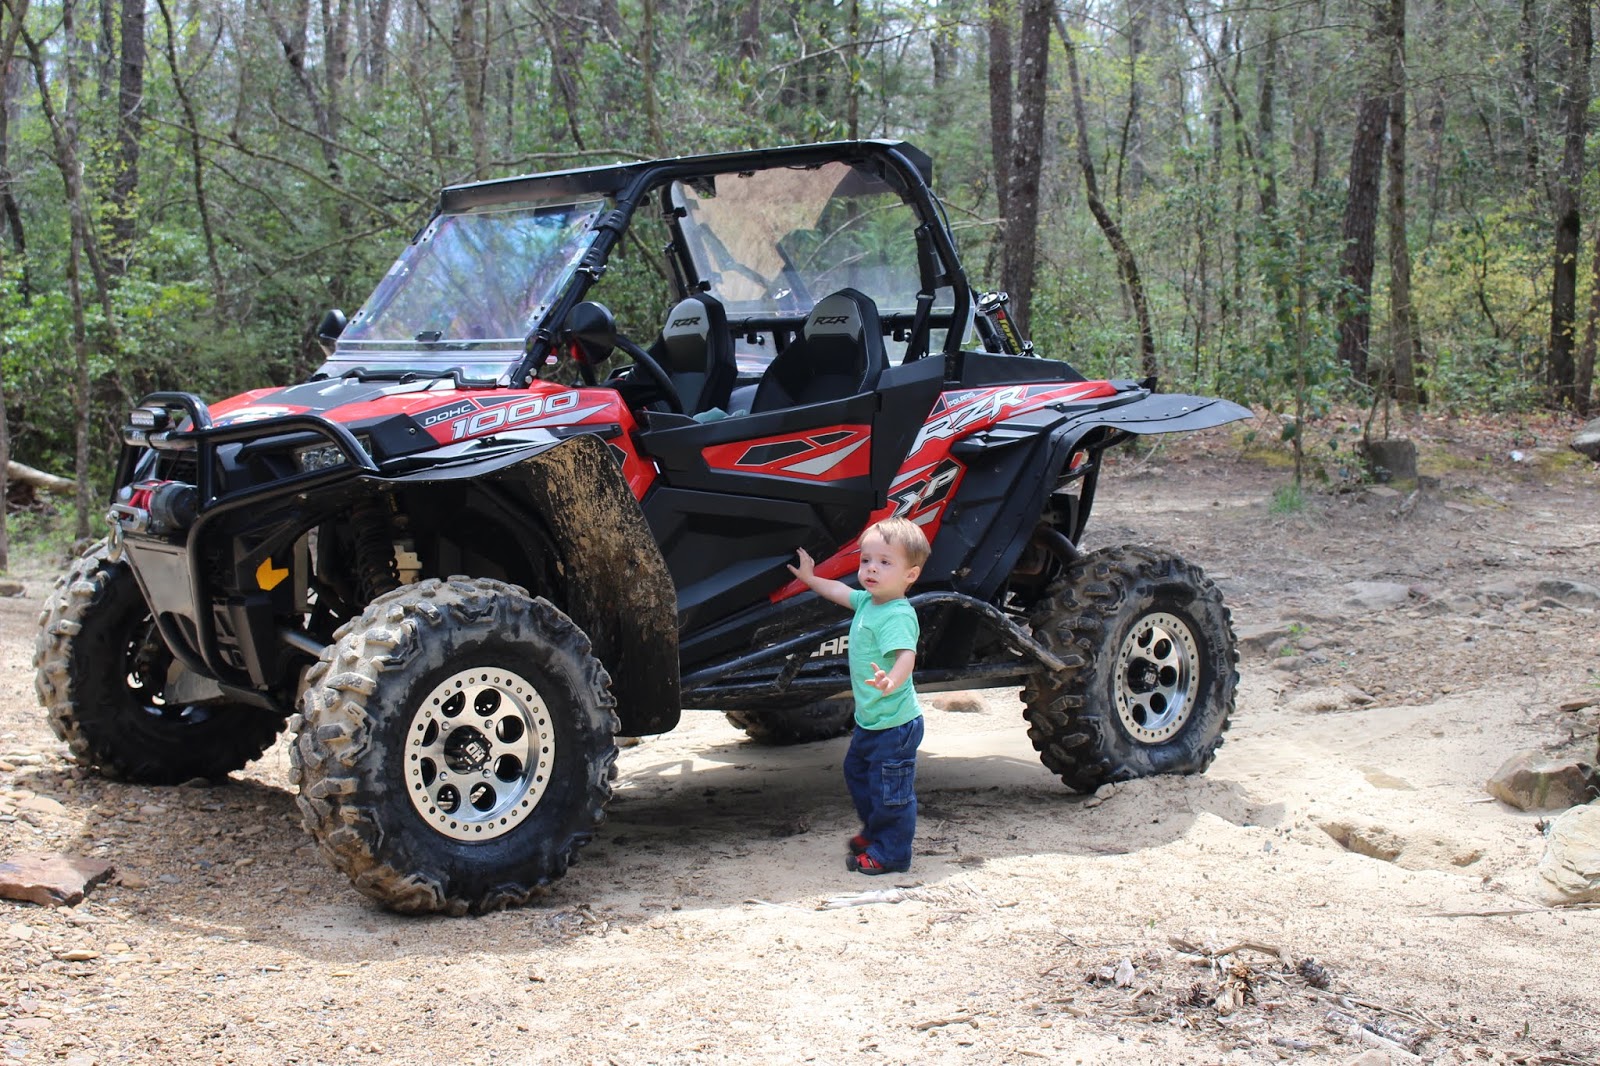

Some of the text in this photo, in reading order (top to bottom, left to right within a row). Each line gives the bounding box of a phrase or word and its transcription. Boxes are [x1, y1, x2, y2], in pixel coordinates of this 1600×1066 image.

[671, 316, 700, 328] RZR
[813, 315, 849, 325] RZR
[947, 391, 976, 407] POLARIS
[424, 403, 473, 426] DOHC
[451, 390, 580, 441] 1000
[906, 386, 1025, 460] RZR
[891, 466, 960, 518] XP
